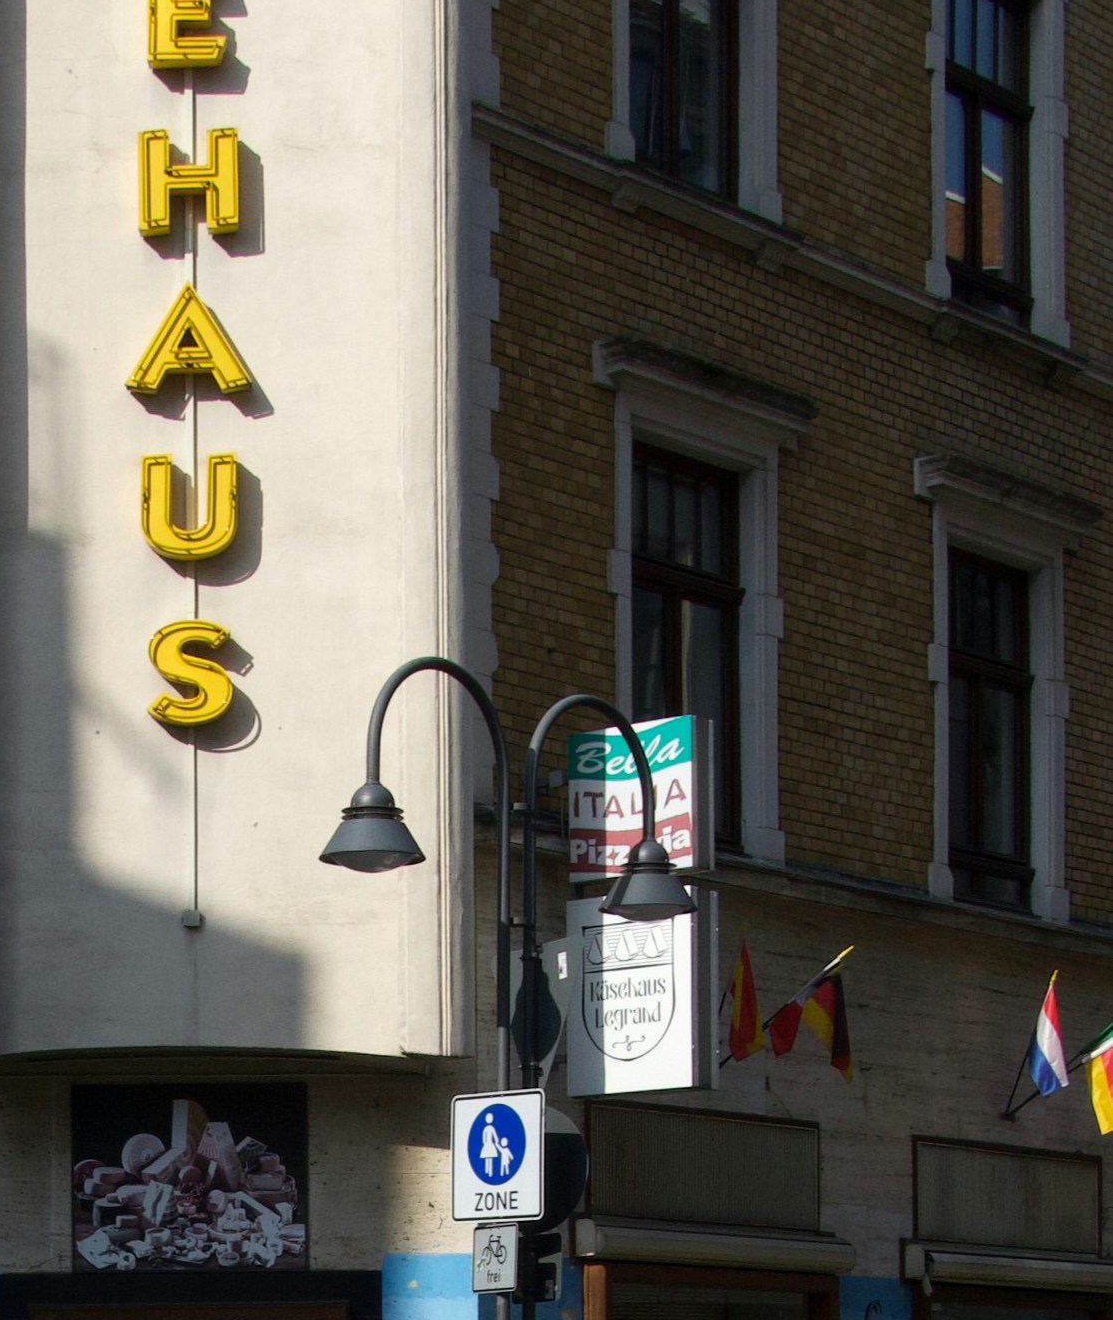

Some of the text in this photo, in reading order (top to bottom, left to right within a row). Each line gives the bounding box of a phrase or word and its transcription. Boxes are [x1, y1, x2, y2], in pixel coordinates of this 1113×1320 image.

[570, 825, 691, 867] Pizzia
[590, 977, 666, 1002] Käsehaus
[595, 1001, 661, 1031] Legrand
[475, 1190, 519, 1212] ZONE
[487, 1269, 501, 1284] frei
